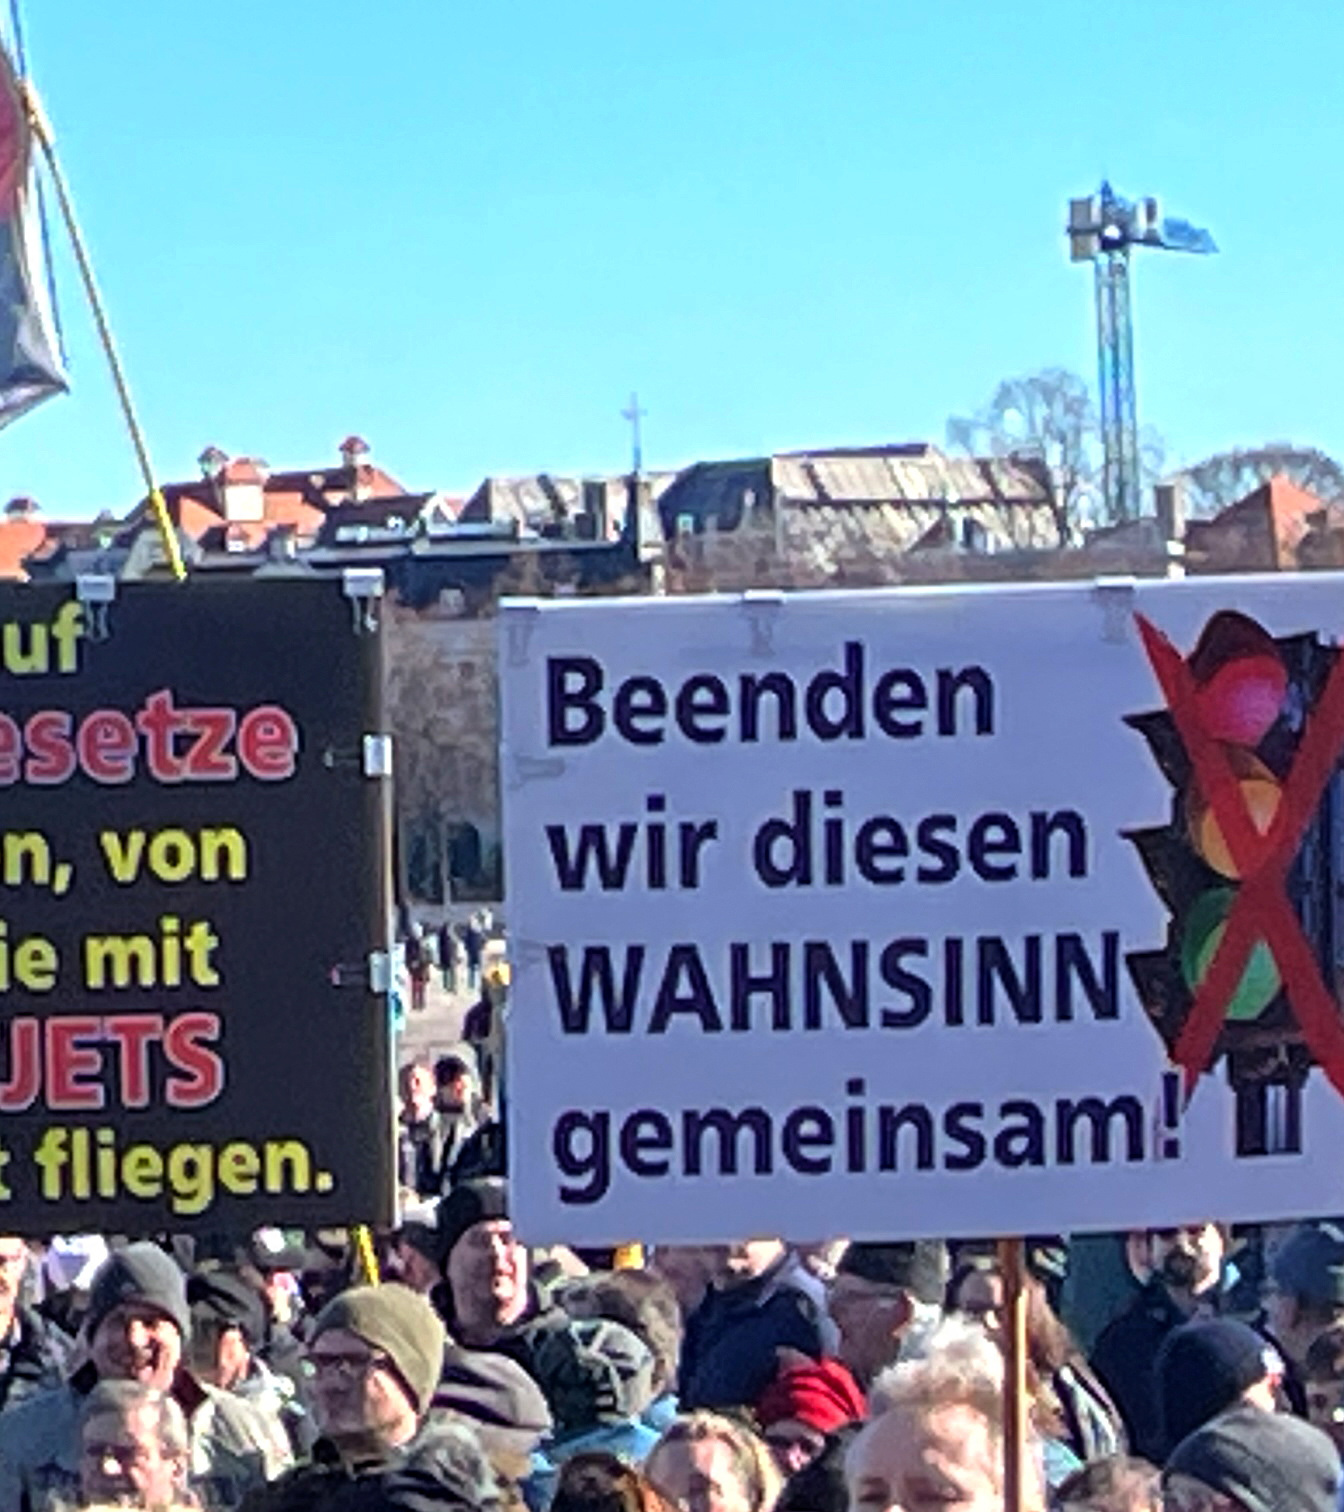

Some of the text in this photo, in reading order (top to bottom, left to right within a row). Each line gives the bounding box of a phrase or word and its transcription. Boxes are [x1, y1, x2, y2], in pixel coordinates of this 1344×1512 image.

[545, 641, 996, 748] Beenden
[101, 826, 247, 884] von
[545, 789, 1089, 892] wir diesen
[85, 915, 219, 988] mit
[545, 929, 1121, 1036] WAHNSINN
[34, 1126, 334, 1213] fliegen.
[552, 1072, 1184, 1205] gemeinsam!
